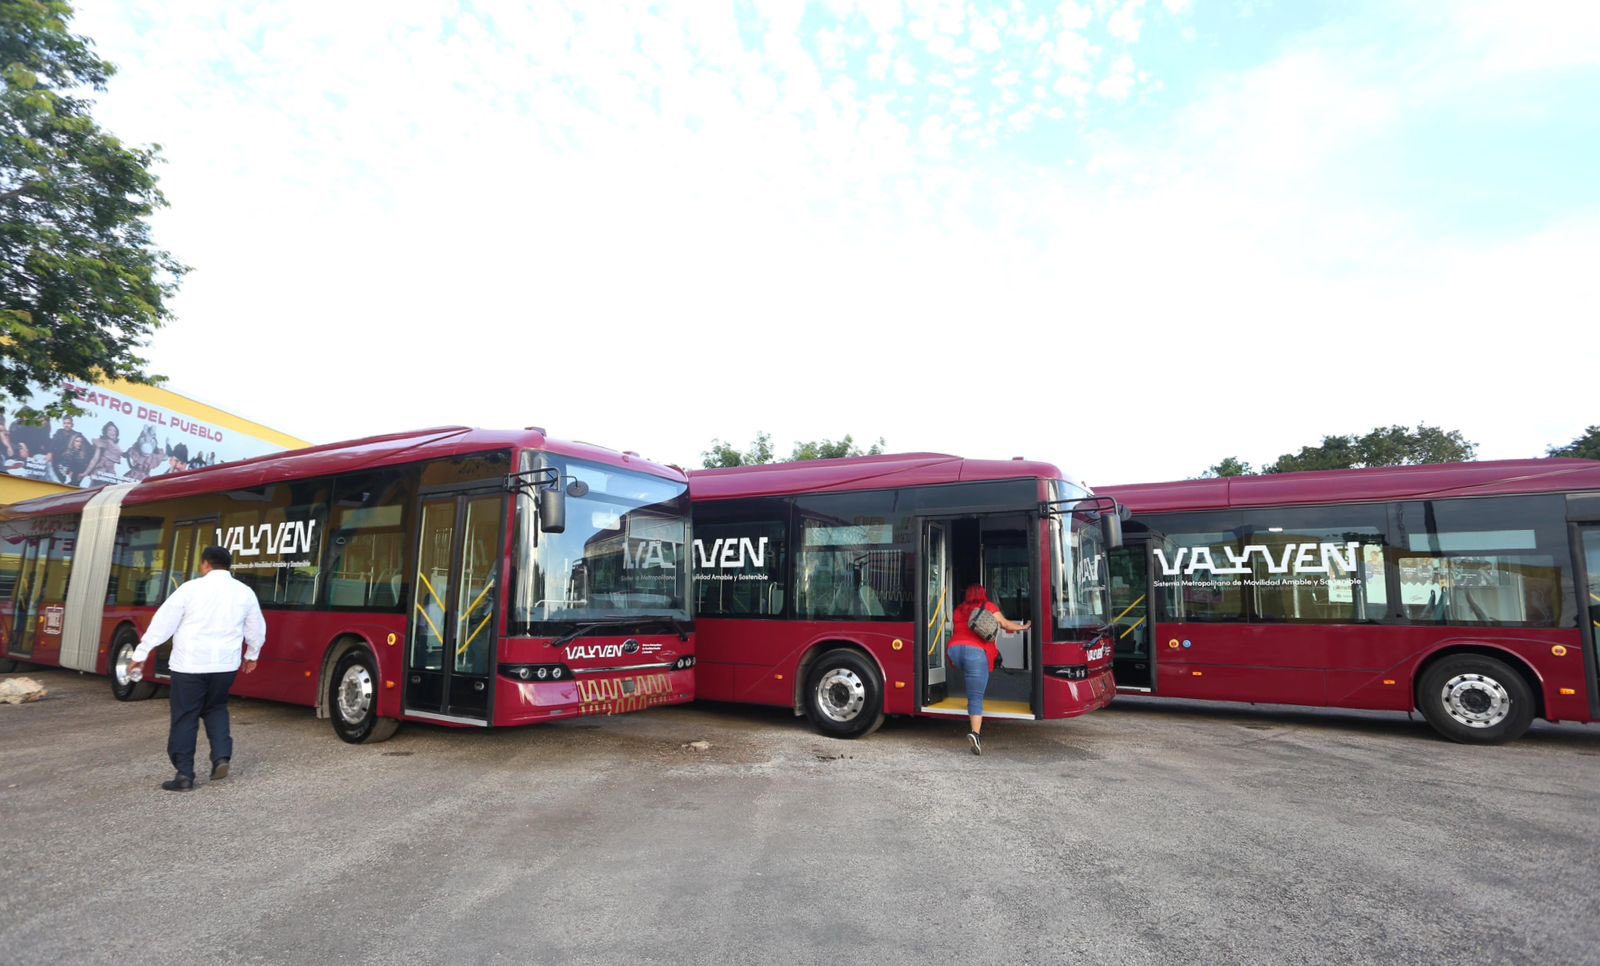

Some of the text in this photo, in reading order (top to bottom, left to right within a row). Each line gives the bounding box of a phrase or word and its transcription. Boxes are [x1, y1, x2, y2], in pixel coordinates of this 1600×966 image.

[137, 406, 167, 426] DEL
[170, 416, 223, 443] PUEBLO
[216, 519, 316, 556] VAYVEN
[621, 536, 768, 569] VAVEN
[1152, 541, 1360, 575] VAYVEN
[733, 575, 738, 583] y
[1153, 580, 1180, 588] Sistema
[1181, 579, 1231, 589] Metropolitano
[1243, 578, 1280, 586] Movilidad
[1281, 578, 1311, 586] Amable
[1319, 577, 1362, 586] Soenible
[565, 644, 624, 660] VAYVEN
